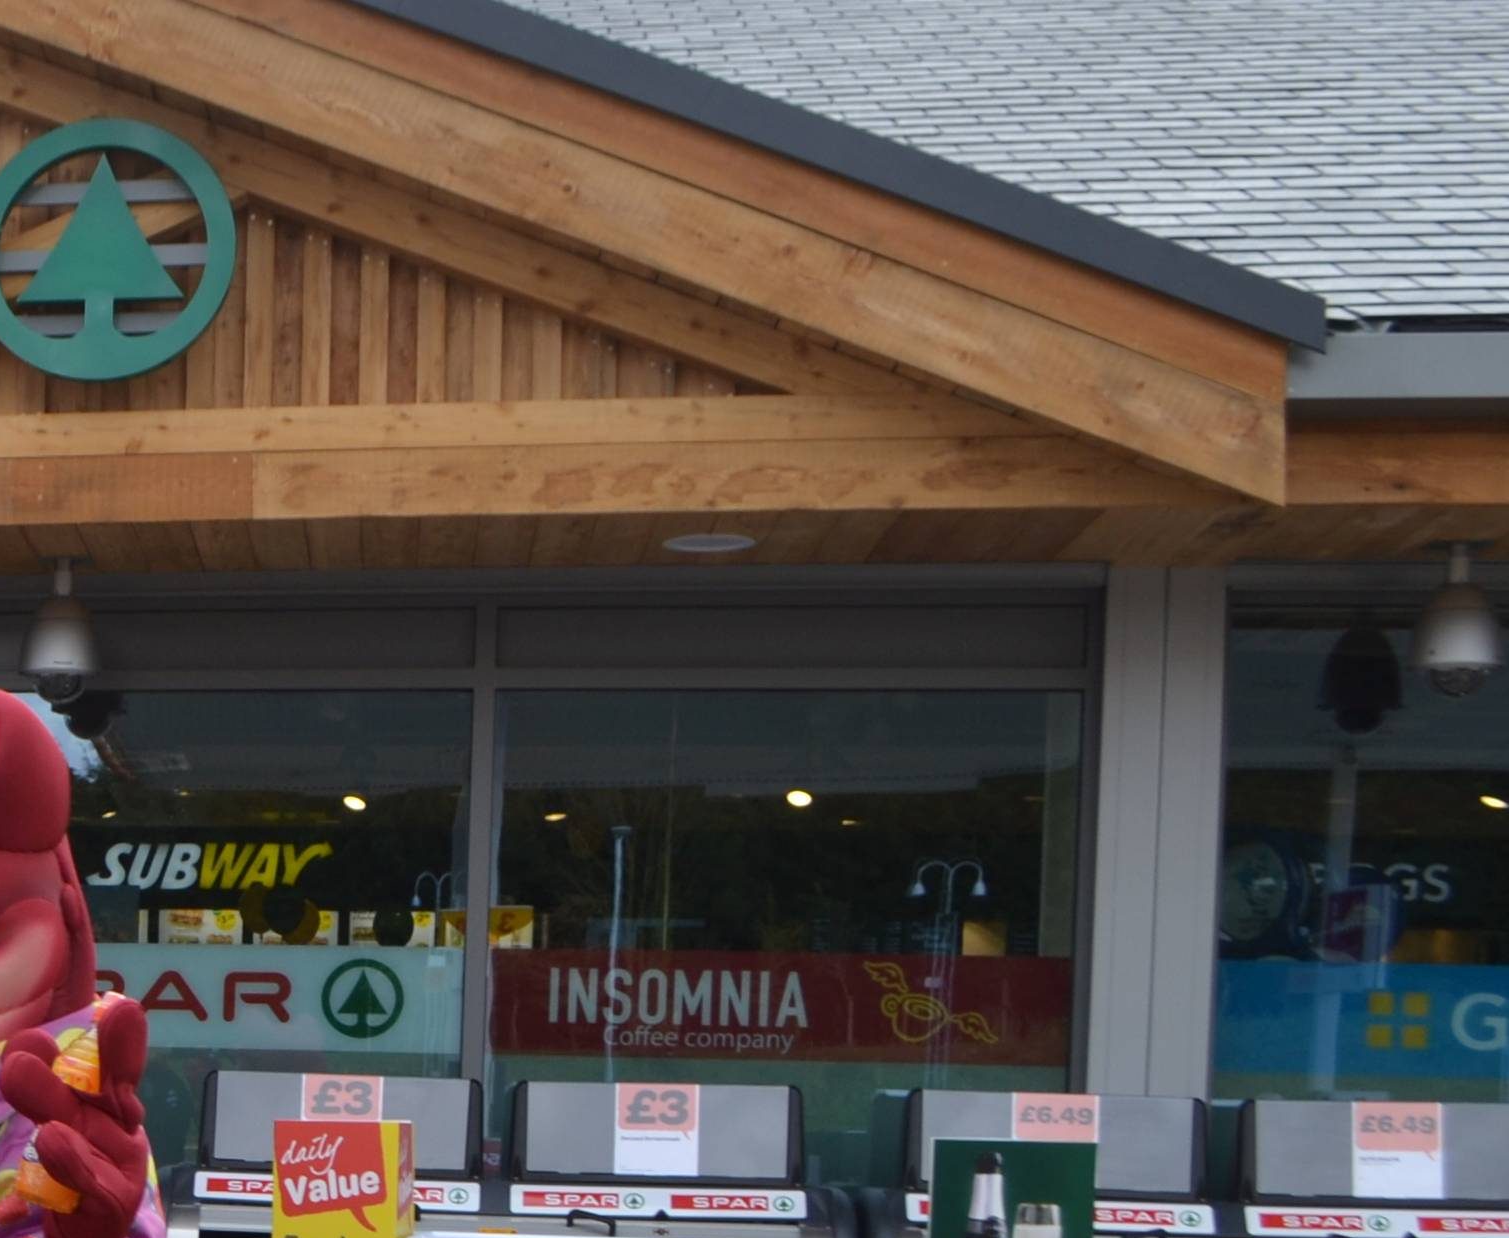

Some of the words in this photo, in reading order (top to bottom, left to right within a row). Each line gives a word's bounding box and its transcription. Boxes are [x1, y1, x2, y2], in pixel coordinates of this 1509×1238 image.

[86, 841, 332, 891] SUBWAY
[547, 967, 809, 1029] INSOMNIA
[603, 1024, 679, 1048] Coffee
[685, 1028, 795, 1053] company
[311, 1080, 373, 1116] £3
[625, 1090, 689, 1126] £3
[1020, 1105, 1094, 1125] £6.49
[1359, 1115, 1437, 1134] £6.49
[281, 1133, 344, 1176] daily
[227, 1180, 274, 1193] SPA
[284, 1168, 380, 1206] Value
[413, 1188, 444, 1201] AR
[544, 1193, 619, 1207] SPAR
[692, 1196, 768, 1210] SPAR
[1095, 1209, 1174, 1224] SPAR
[1281, 1215, 1364, 1230] SPAR
